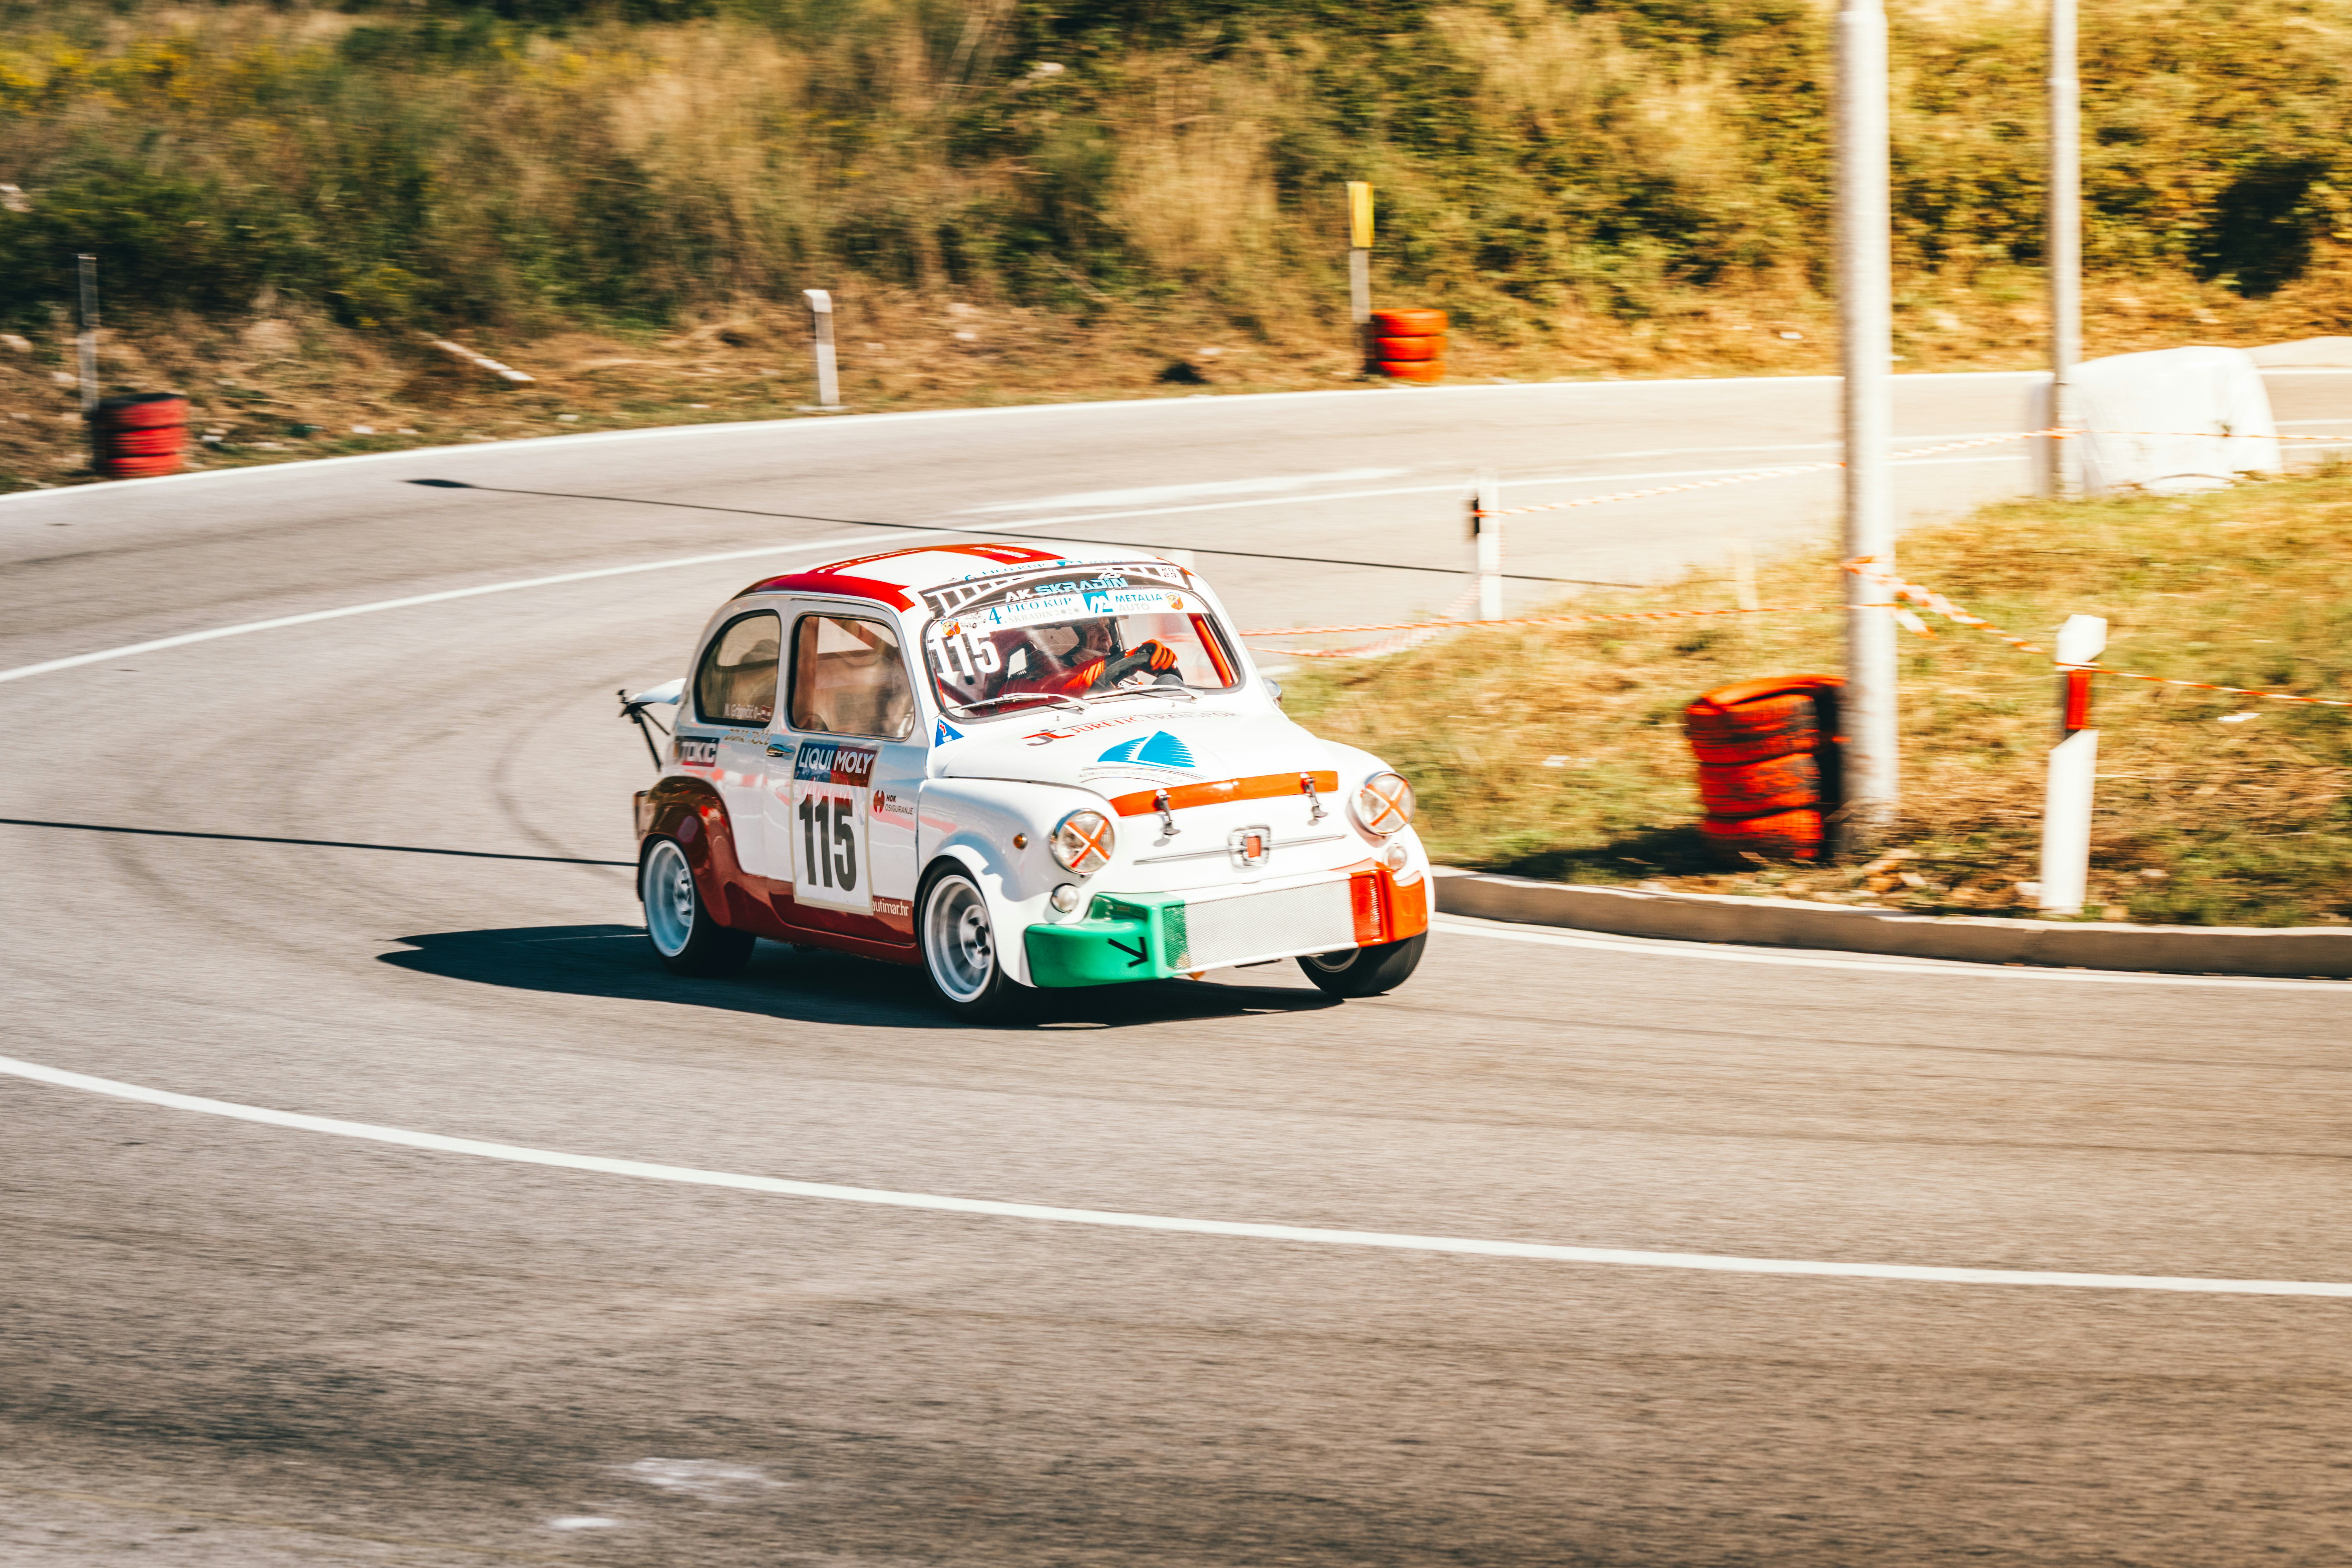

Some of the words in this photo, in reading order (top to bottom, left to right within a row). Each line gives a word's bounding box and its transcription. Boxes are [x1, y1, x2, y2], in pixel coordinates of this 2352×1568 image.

[1005, 589, 1033, 602] AK
[1035, 578, 1129, 595] SKRADIN
[1115, 593, 1163, 602] METALIA
[1007, 602, 1039, 612] FICO
[1045, 597, 1072, 607] KUP
[1119, 604, 1150, 612] AUTO
[1009, 610, 1053, 623] SKRADIN
[928, 632, 1001, 679] 115
[680, 739, 717, 762] TOKIĆ
[798, 748, 835, 770] LIQUI
[833, 751, 875, 774] MOLY
[886, 794, 897, 803] HOK
[885, 804, 913, 815] OSIGURANJE
[799, 794, 856, 892] 115
